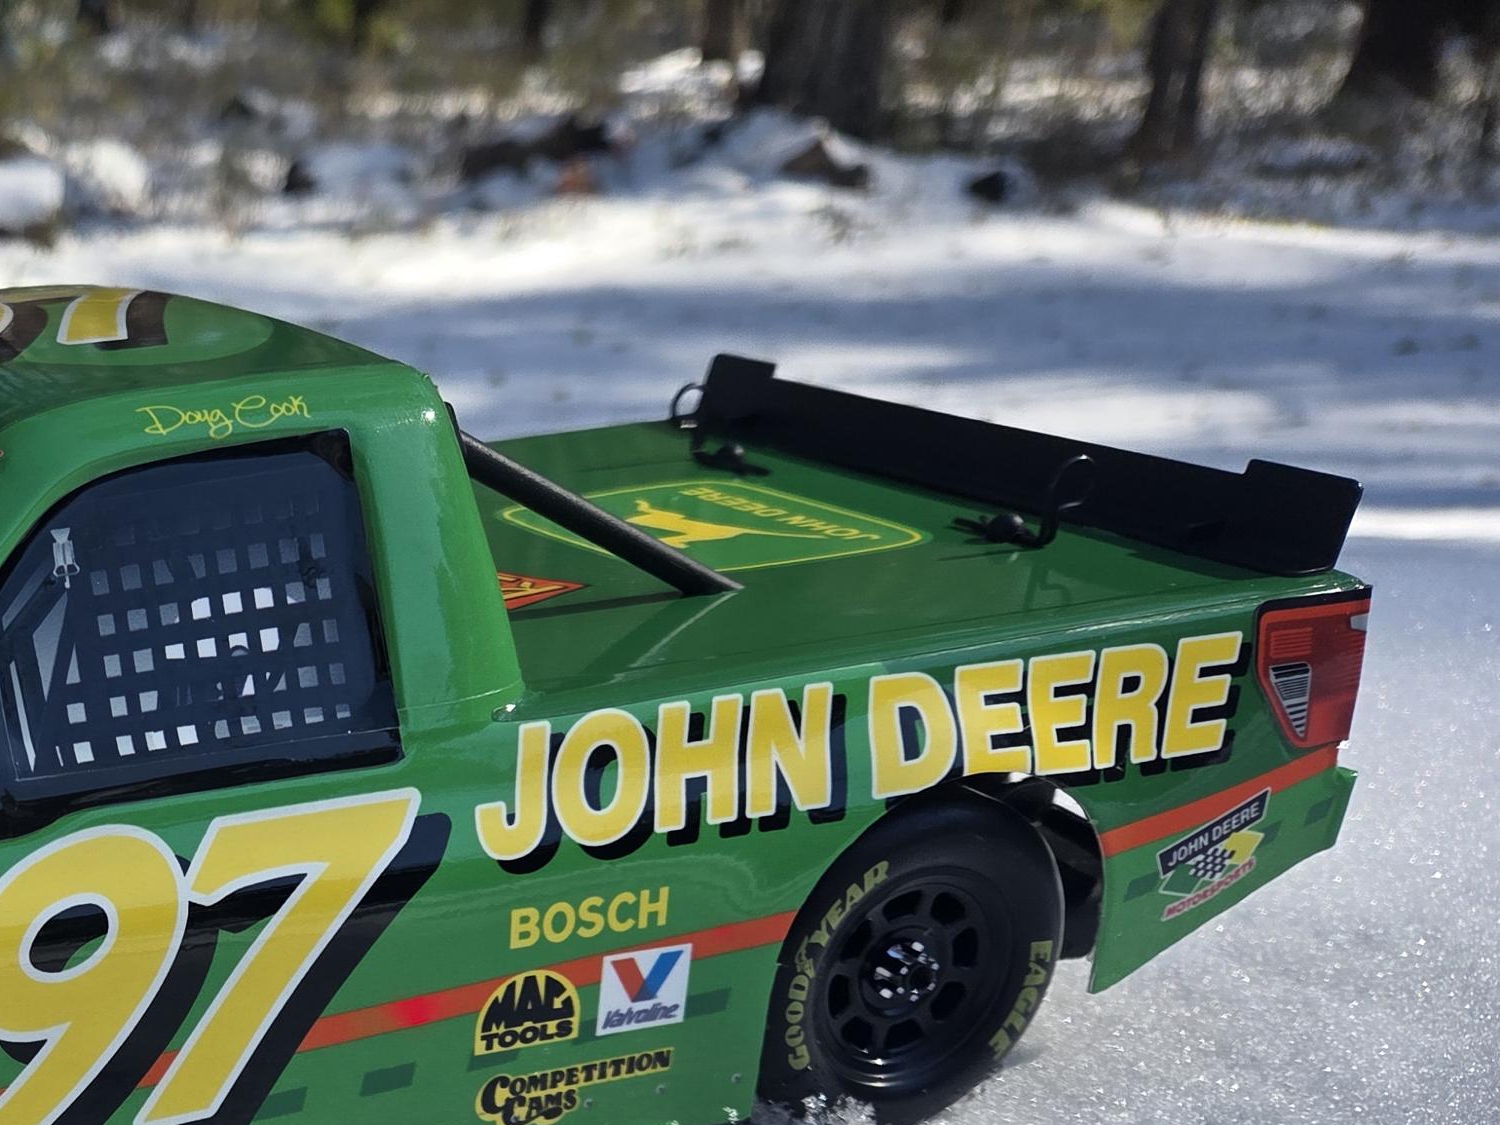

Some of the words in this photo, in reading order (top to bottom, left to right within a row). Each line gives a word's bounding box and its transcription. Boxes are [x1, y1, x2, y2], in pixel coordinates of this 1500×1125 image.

[135, 405, 233, 440] Doug
[232, 395, 311, 428] Cook
[679, 487, 789, 518] DEERE
[775, 515, 882, 541] JOHN
[474, 682, 835, 862] JOHN
[871, 630, 1244, 800] DEERE
[1167, 832, 1209, 867] JOHN
[1211, 801, 1260, 841] DEERE
[510, 886, 670, 950] BOSCH
[481, 974, 575, 1034] MAC
[601, 1002, 680, 1030] Valvoline
[988, 940, 1053, 1061] EAGLE
[480, 1020, 573, 1051] TOOLS
